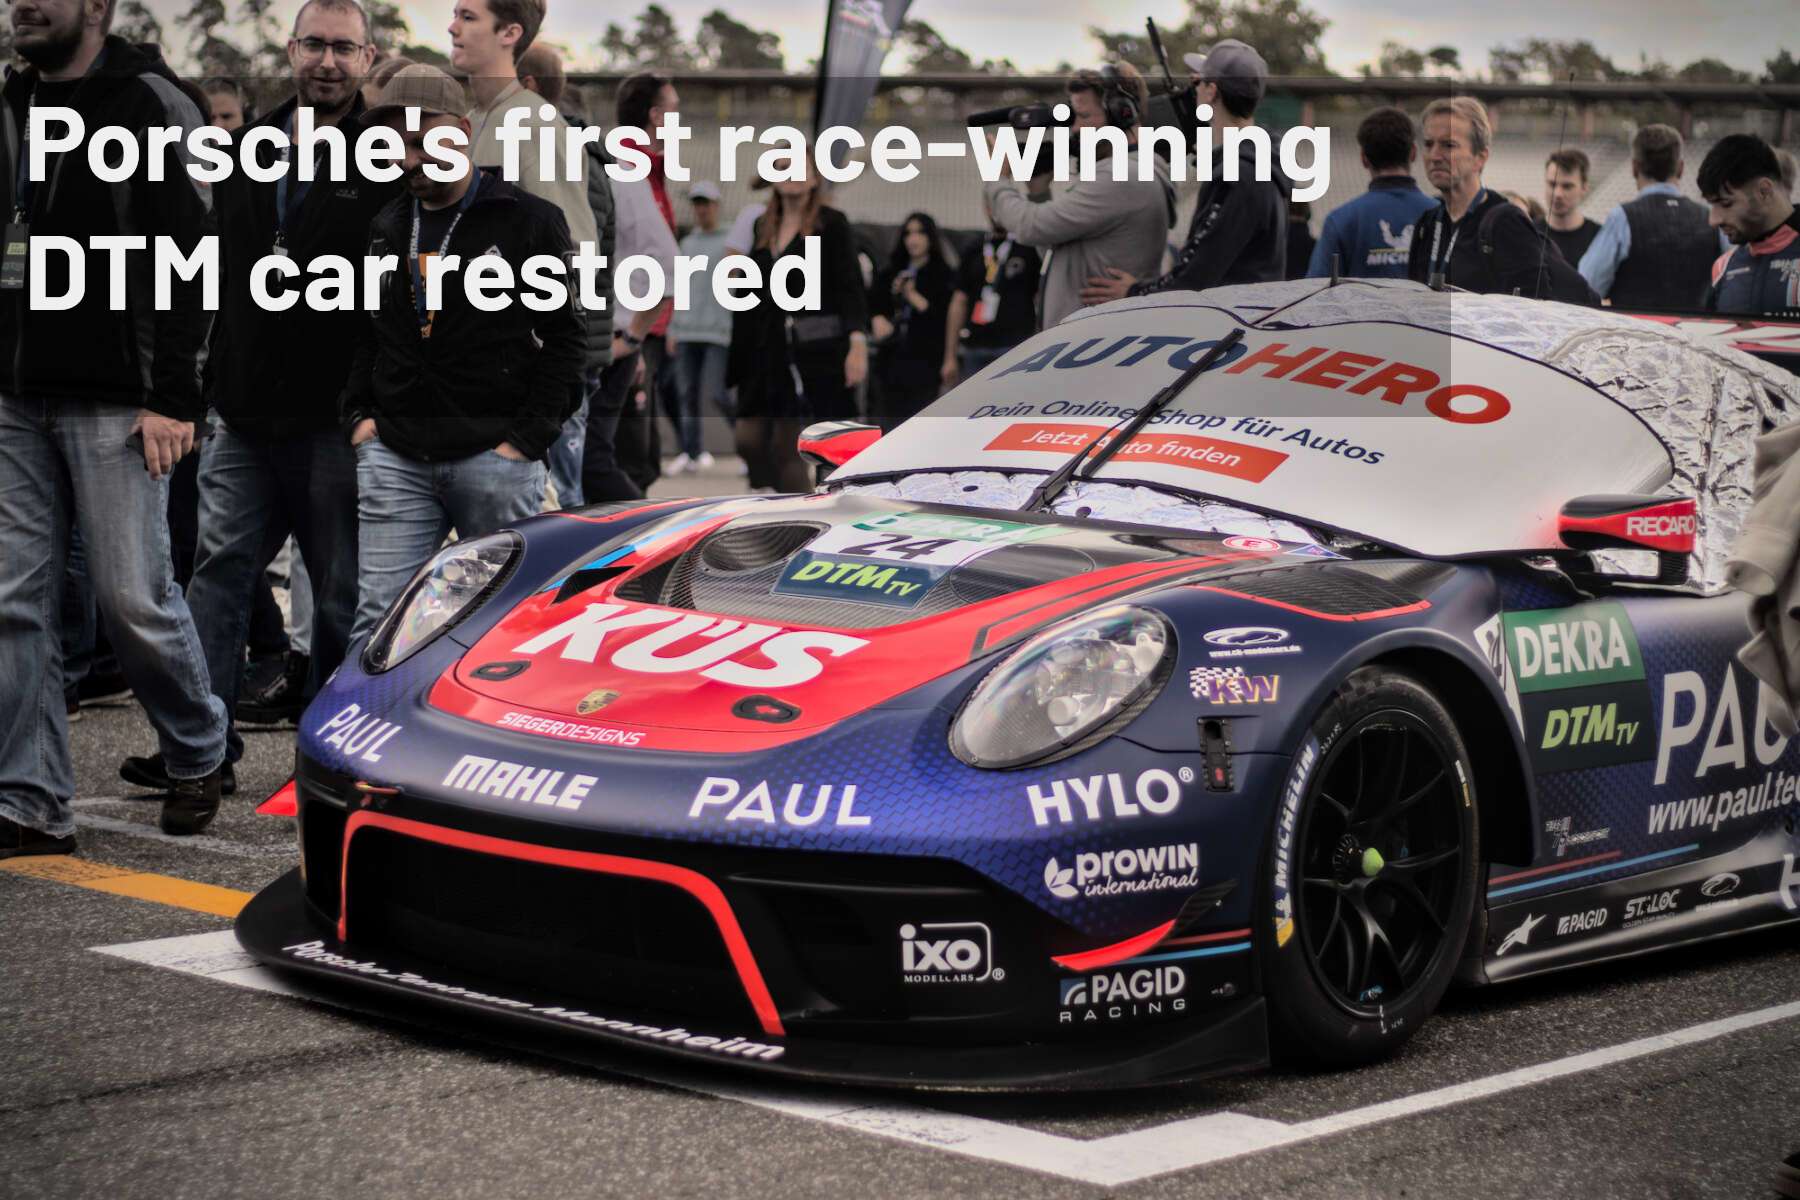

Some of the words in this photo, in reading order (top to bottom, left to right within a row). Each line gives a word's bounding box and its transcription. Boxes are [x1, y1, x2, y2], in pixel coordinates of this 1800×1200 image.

[988, 335, 1512, 425] AUTOHERO
[967, 401, 1035, 420] Dein
[1231, 416, 1284, 438] für
[1281, 428, 1385, 465] Autos
[1023, 429, 1090, 447] Jetzt
[1155, 440, 1241, 468] finden
[1626, 515, 1696, 537] RECARO
[837, 533, 959, 560] 24
[790, 560, 899, 589] DTM
[1514, 616, 1632, 679] DEKRA
[1207, 674, 1281, 705] KW
[316, 703, 402, 763] PAUL
[496, 711, 647, 747] SIEGERDESIGNS
[1541, 702, 1617, 749] DTM
[1616, 720, 1640, 746] TV
[442, 754, 599, 810] MAHLE
[688, 776, 872, 827] PAUL
[1274, 744, 1314, 889] MICHELIN
[1084, 867, 1199, 897] international
[1569, 908, 1608, 933] PAGID
[1091, 965, 1186, 1004] PAGID
[1059, 998, 1186, 1023] RACING
